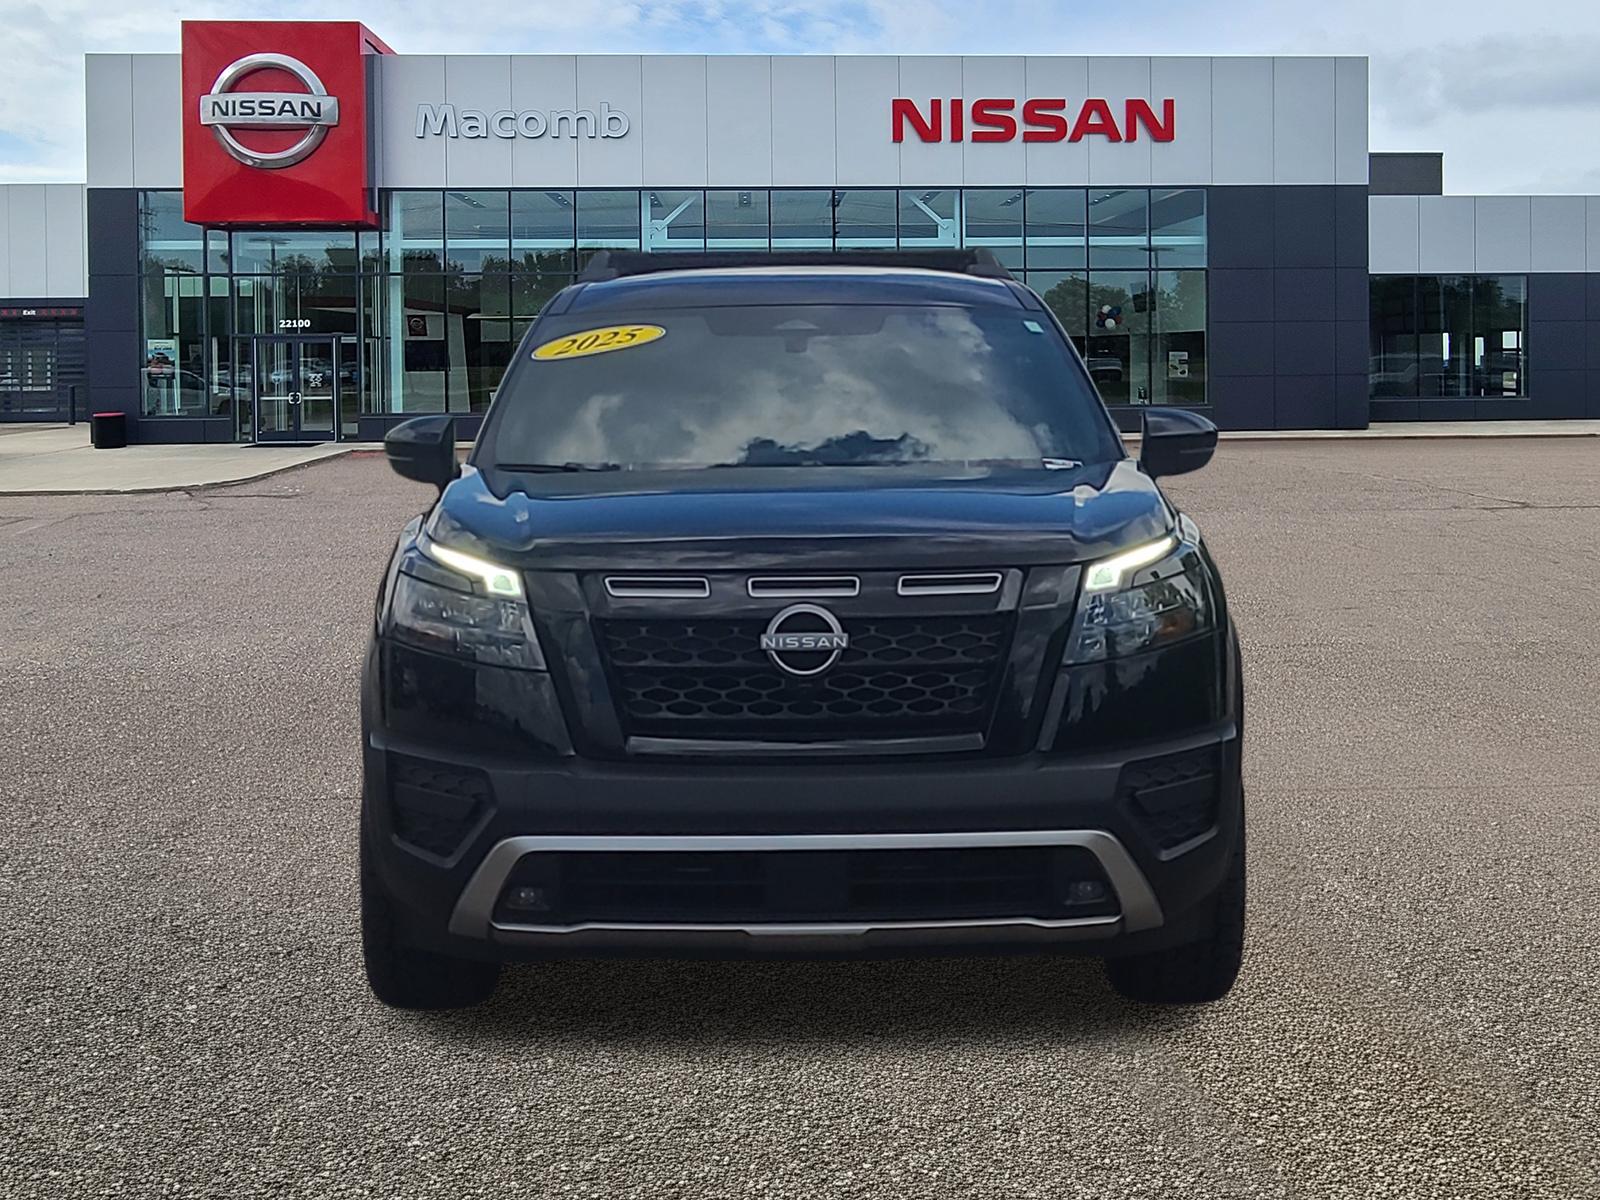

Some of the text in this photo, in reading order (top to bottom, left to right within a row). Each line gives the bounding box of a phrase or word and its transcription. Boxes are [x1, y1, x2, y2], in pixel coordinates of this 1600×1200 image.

[211, 100, 322, 118] NISSAN
[415, 102, 630, 139] Macomb
[892, 98, 1175, 142] NISSAN
[279, 319, 311, 328] 22100
[553, 327, 644, 355] 2025
[763, 637, 847, 648] NISSAN
